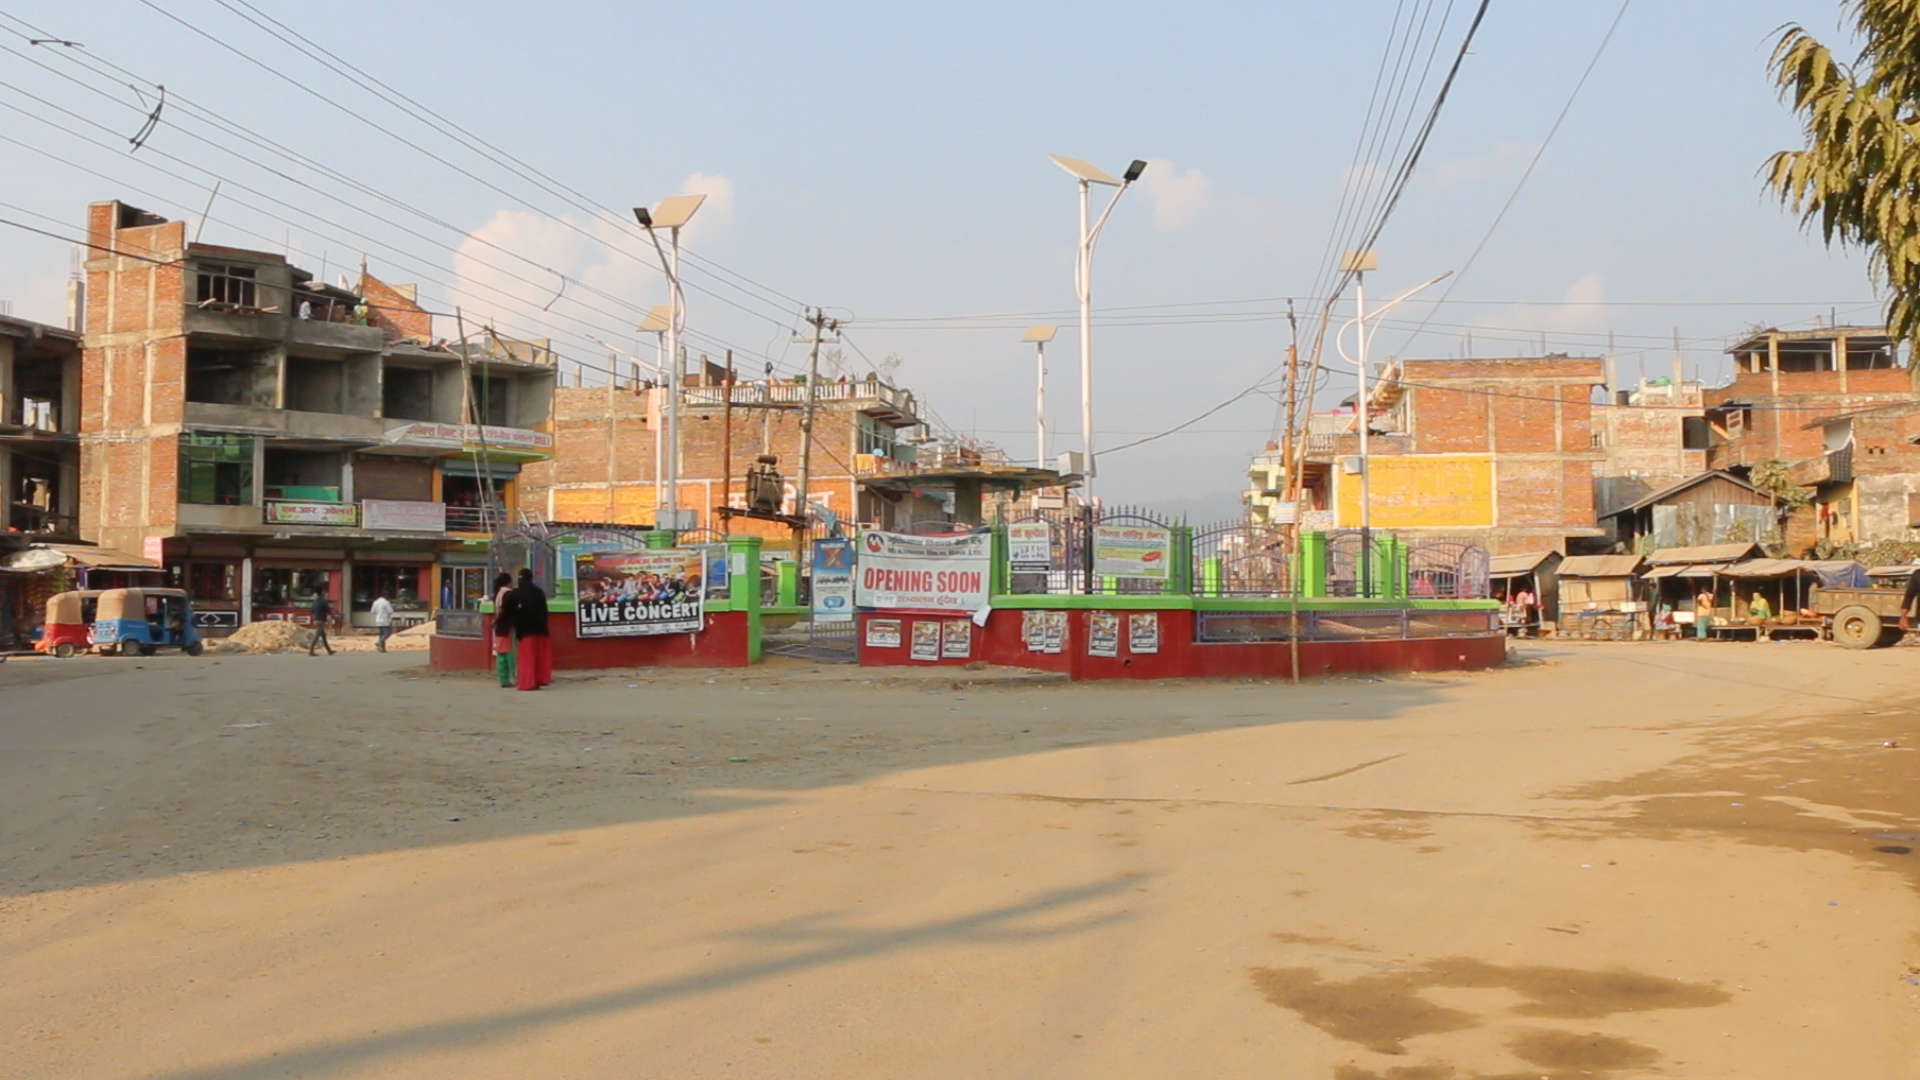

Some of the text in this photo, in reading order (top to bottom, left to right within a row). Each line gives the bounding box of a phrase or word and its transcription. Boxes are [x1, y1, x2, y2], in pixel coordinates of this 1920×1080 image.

[864, 567, 981, 594] OPENING SOON
[581, 602, 699, 623] LIVE CONCERT
